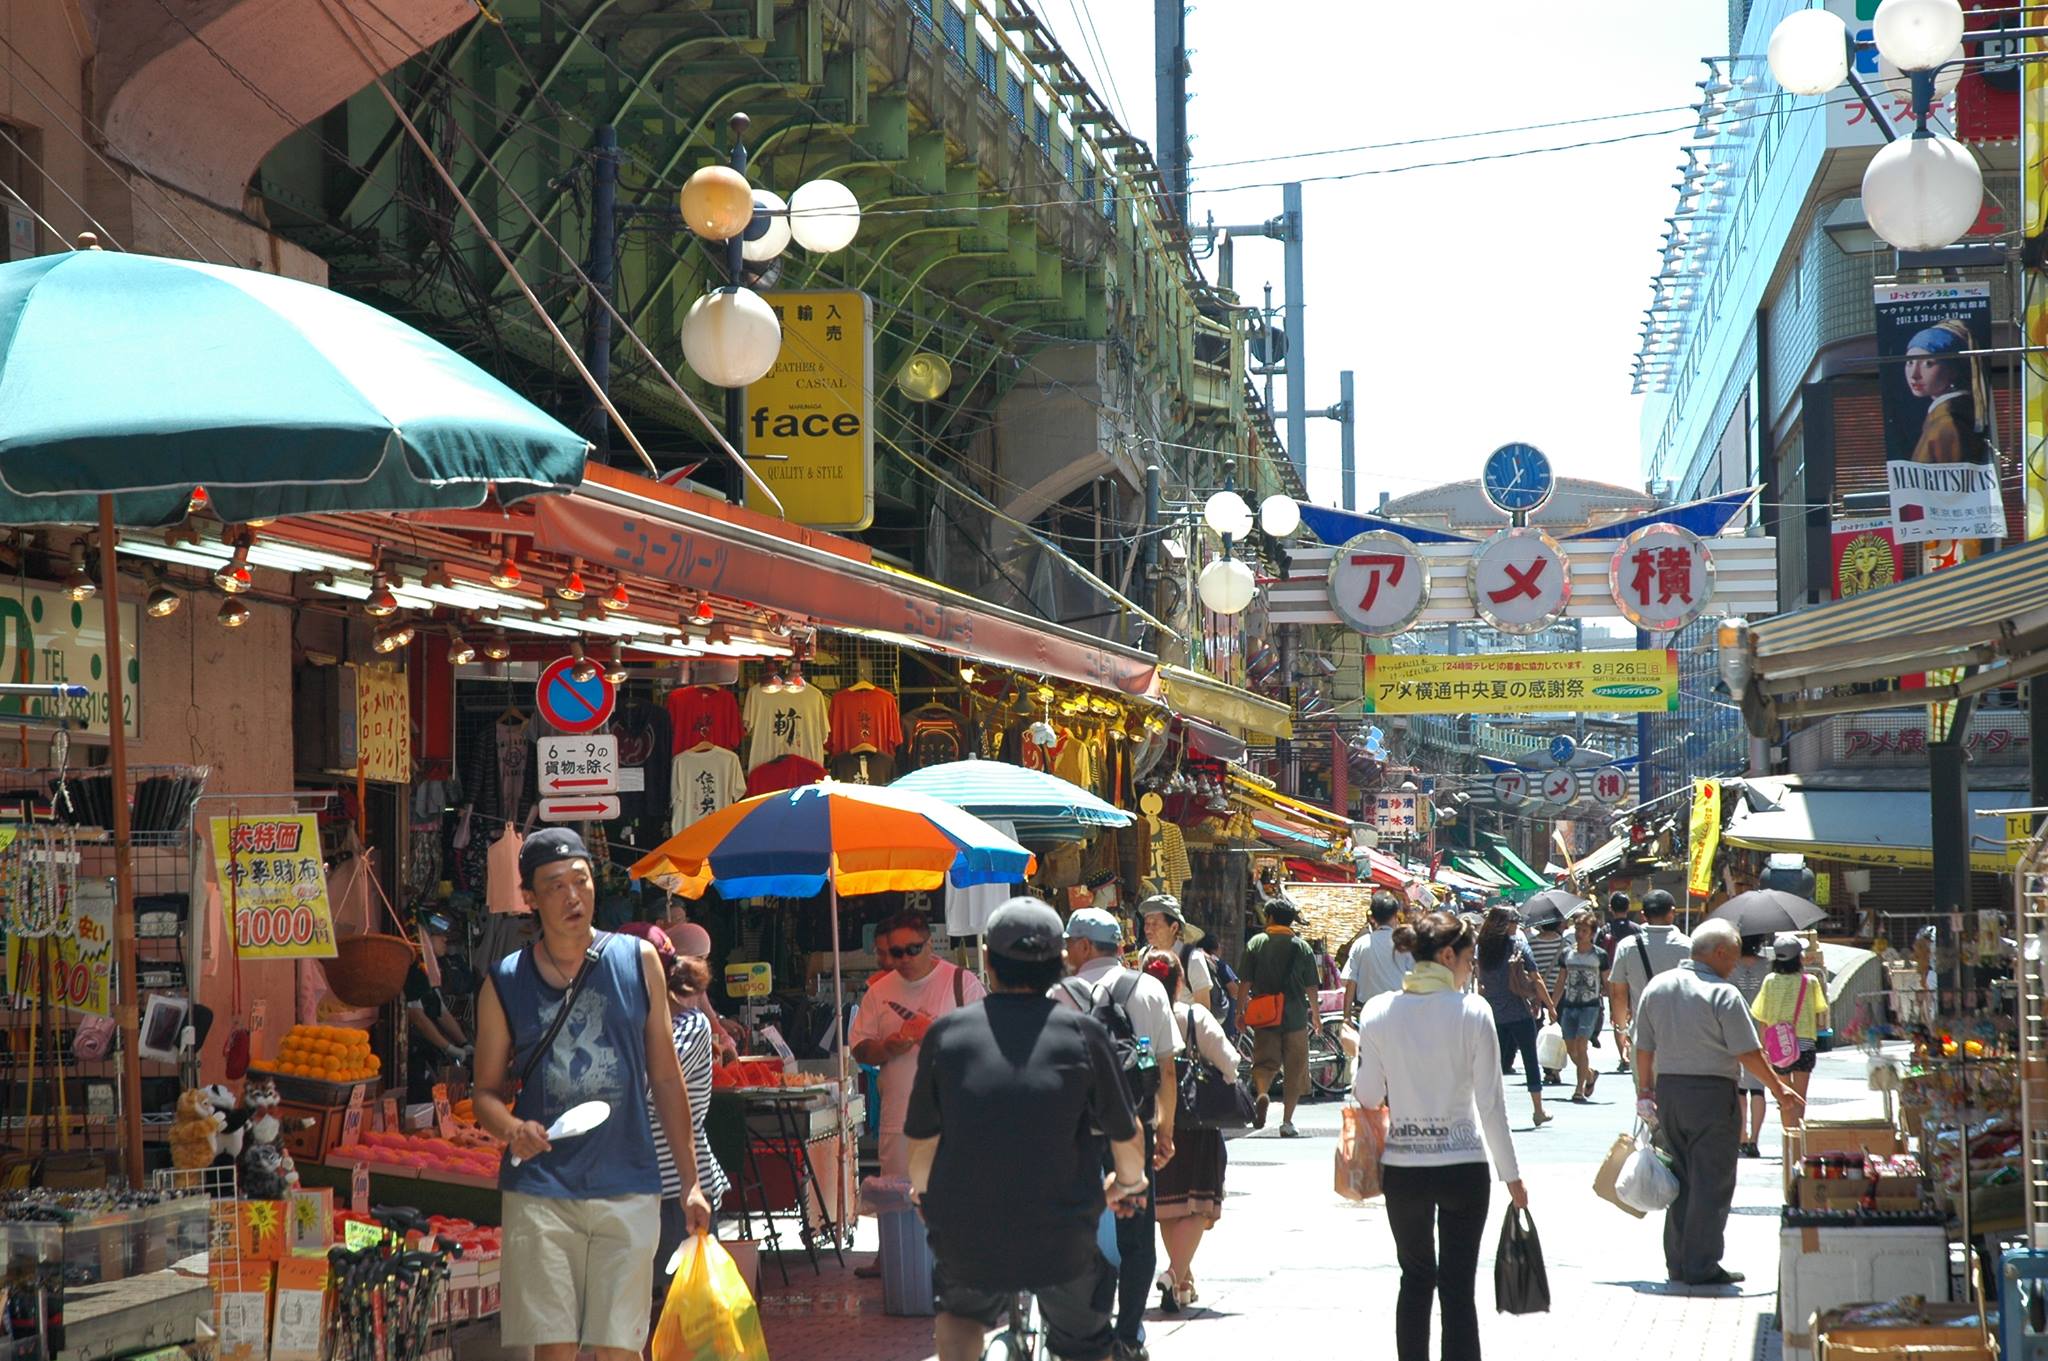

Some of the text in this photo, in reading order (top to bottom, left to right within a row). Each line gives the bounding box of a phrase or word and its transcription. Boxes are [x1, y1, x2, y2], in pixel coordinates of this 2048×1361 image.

[795, 377, 848, 389] CASUAL
[751, 405, 861, 438] face
[767, 465, 844, 480] QUALITY & STYLE
[1892, 466, 1996, 493] MAURITSHUIS
[613, 520, 730, 593] ニューフルーツ
[1350, 547, 1694, 612] アメ横
[42, 649, 69, 682] TEL
[1592, 663, 1646, 675] 8月26日
[1379, 679, 1585, 701] アメ横通中央夏の感謝祭
[773, 707, 802, 747] 斬
[1844, 728, 2030, 759] アメ横ター
[545, 758, 613, 776] 貨物を除く
[229, 823, 303, 853] 大特価
[236, 905, 314, 947] 1000
